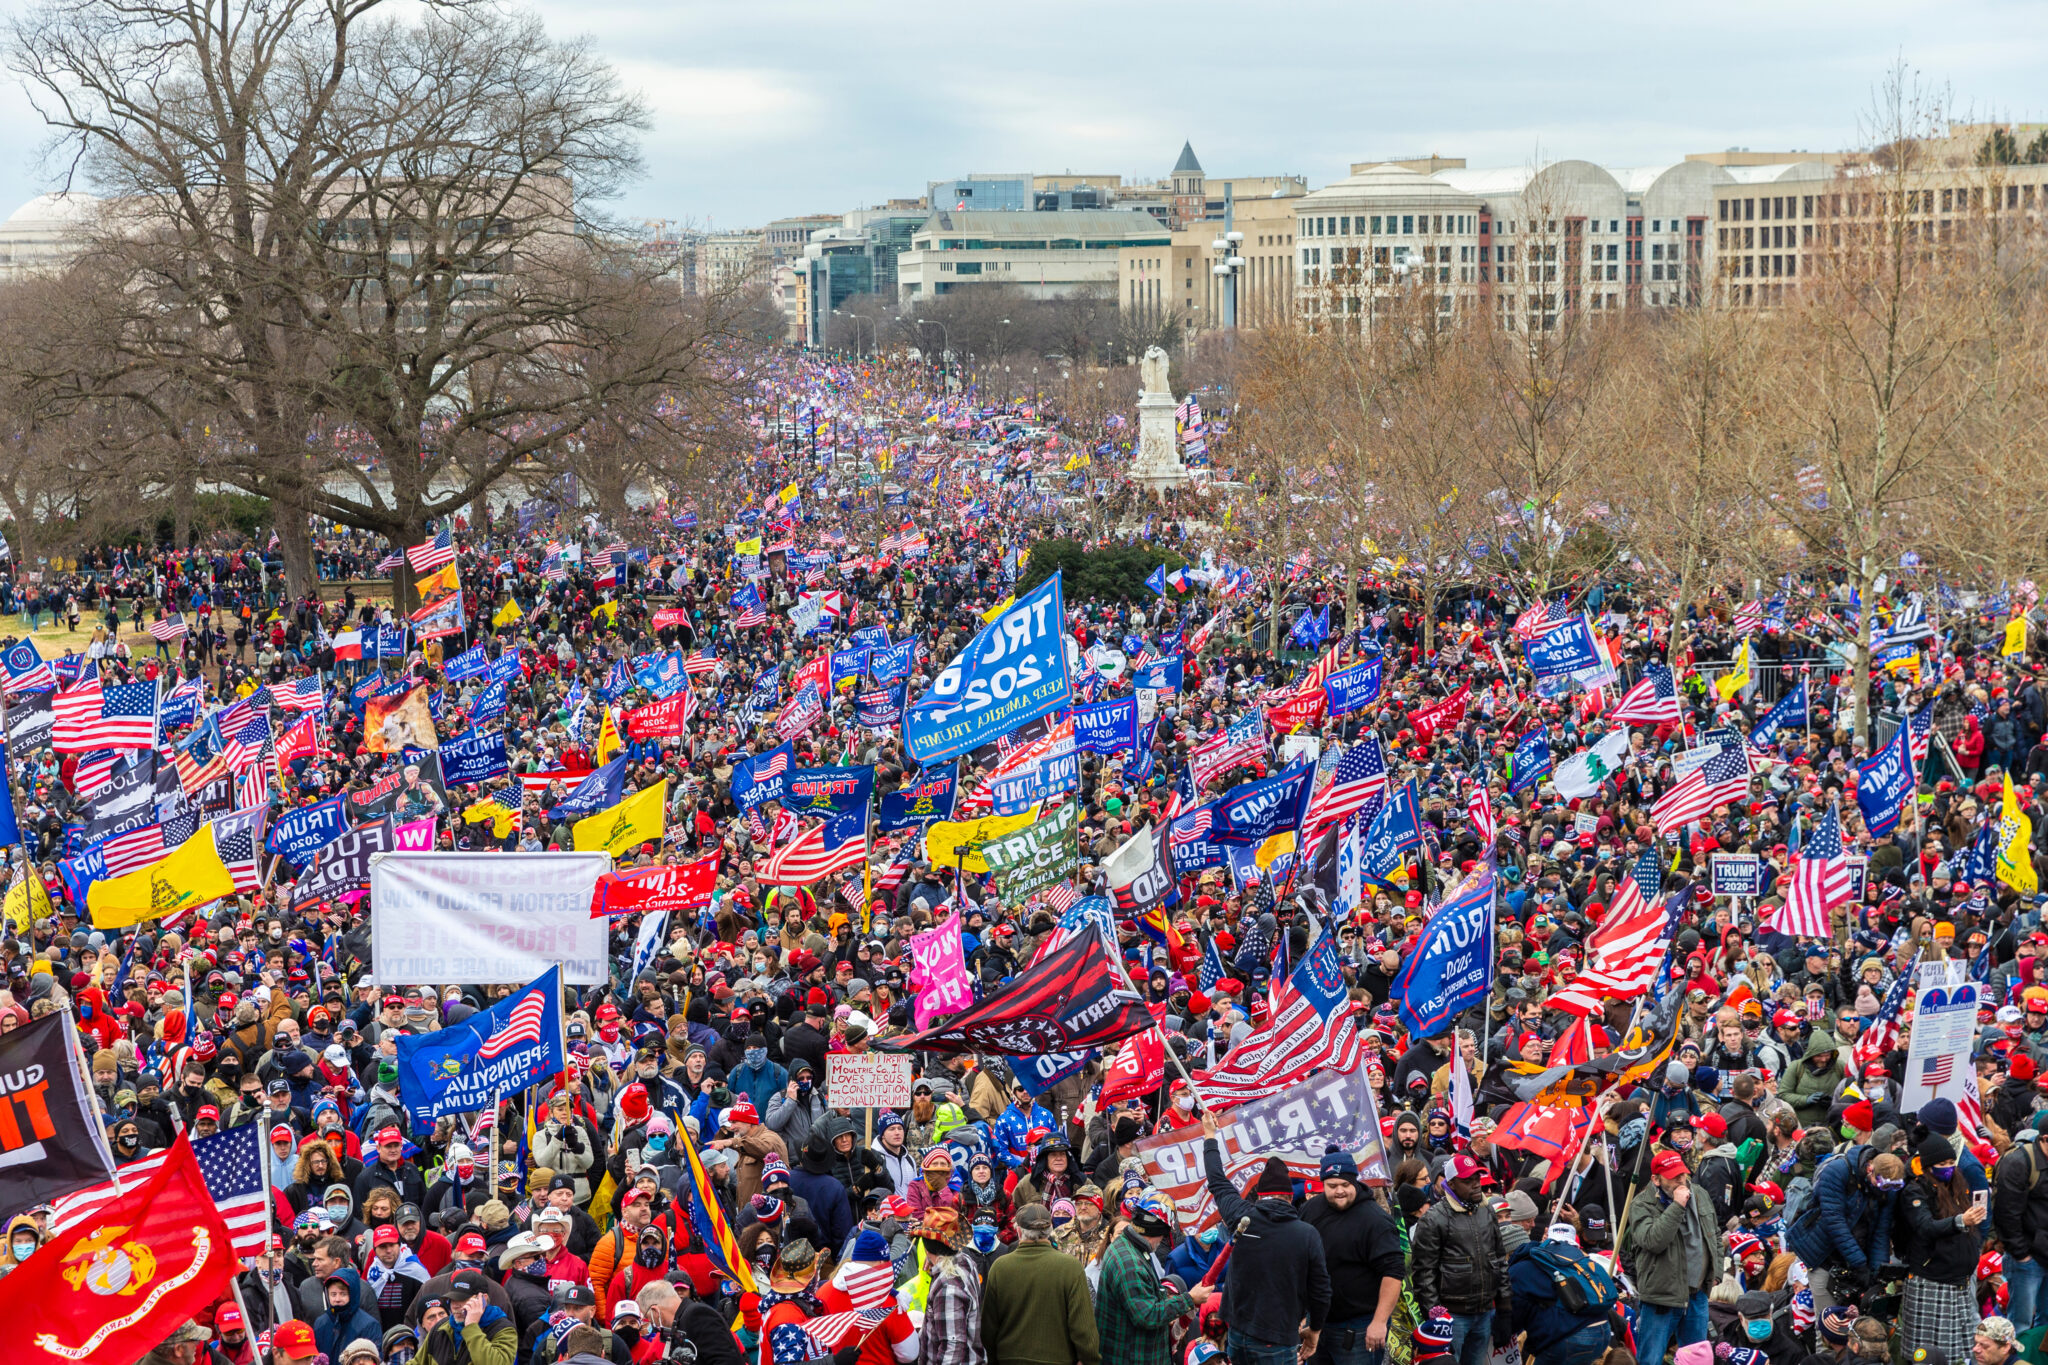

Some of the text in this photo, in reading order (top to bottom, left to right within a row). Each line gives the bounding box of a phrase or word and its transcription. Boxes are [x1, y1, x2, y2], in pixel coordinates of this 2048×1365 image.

[459, 754, 495, 770] -2020-
[1007, 842, 1064, 885] PECE
[1716, 864, 1755, 877] TRUMP
[2001, 868, 2016, 882] ON
[1724, 882, 1748, 891] 2020
[1920, 1004, 1932, 1015] Ten
[831, 1075, 865, 1084] LOVES
[837, 1095, 876, 1106] DONALD
[876, 1095, 910, 1106] TRUMP
[1588, 1218, 1605, 1226] Trump
